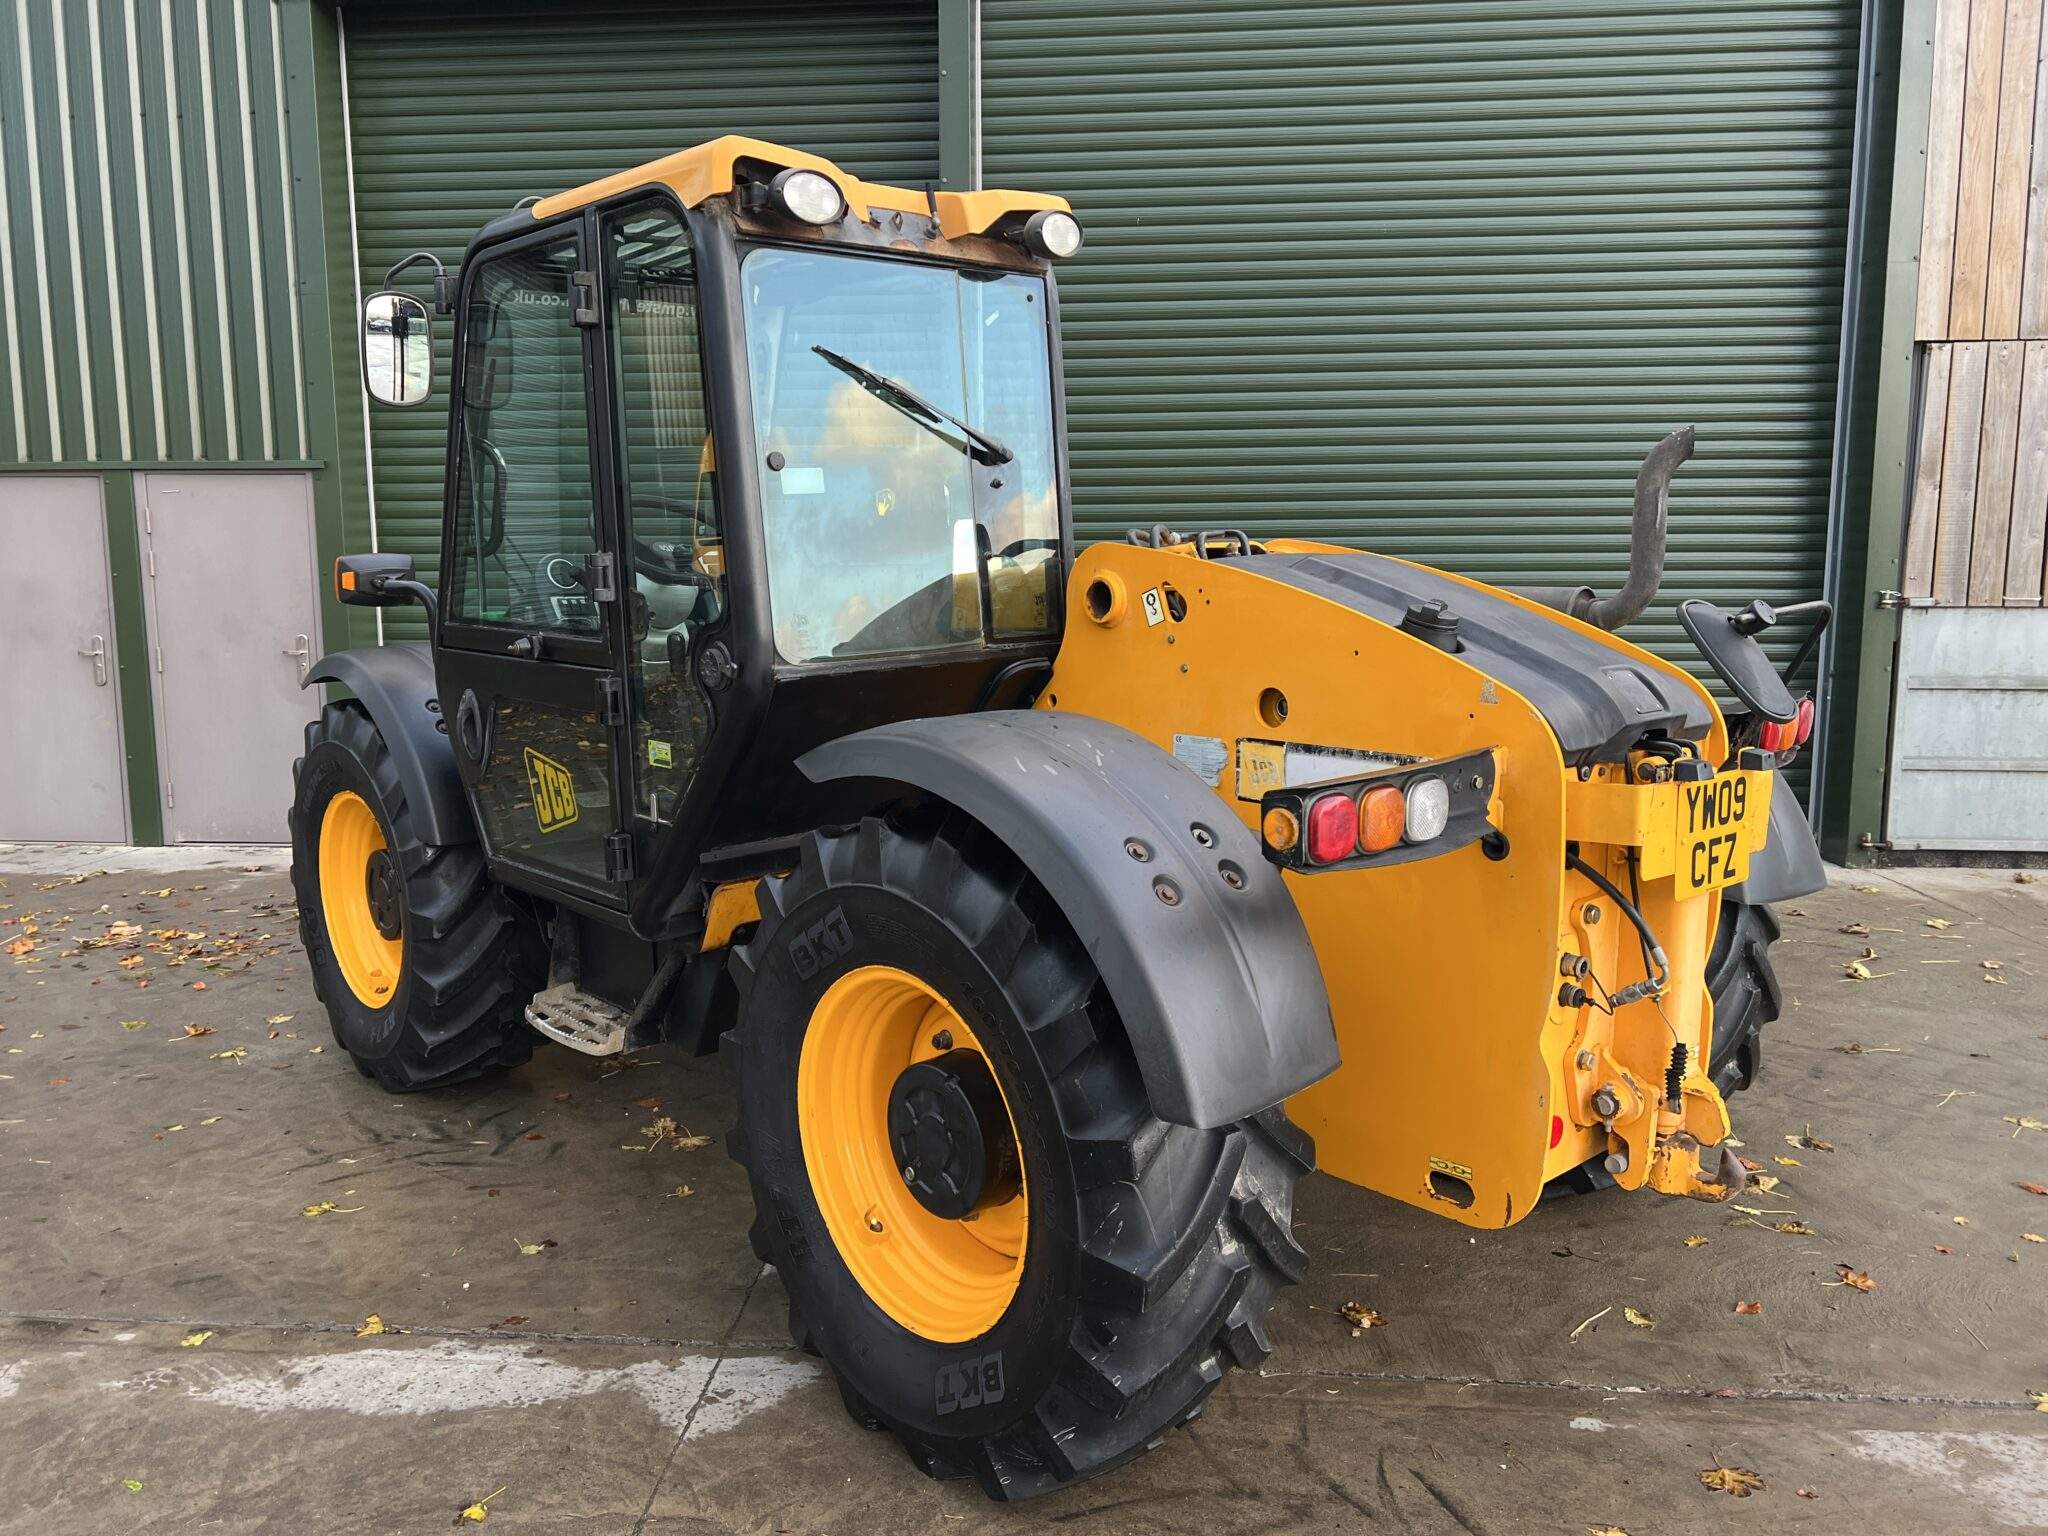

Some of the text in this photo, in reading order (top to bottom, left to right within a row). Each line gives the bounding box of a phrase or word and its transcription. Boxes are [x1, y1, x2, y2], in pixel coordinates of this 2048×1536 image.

[533, 757, 575, 825] JCB
[1686, 776, 1747, 833] YW09
[1691, 832, 1737, 888] CFZ
[789, 909, 850, 977] BKT
[936, 1356, 1003, 1411] BKT
